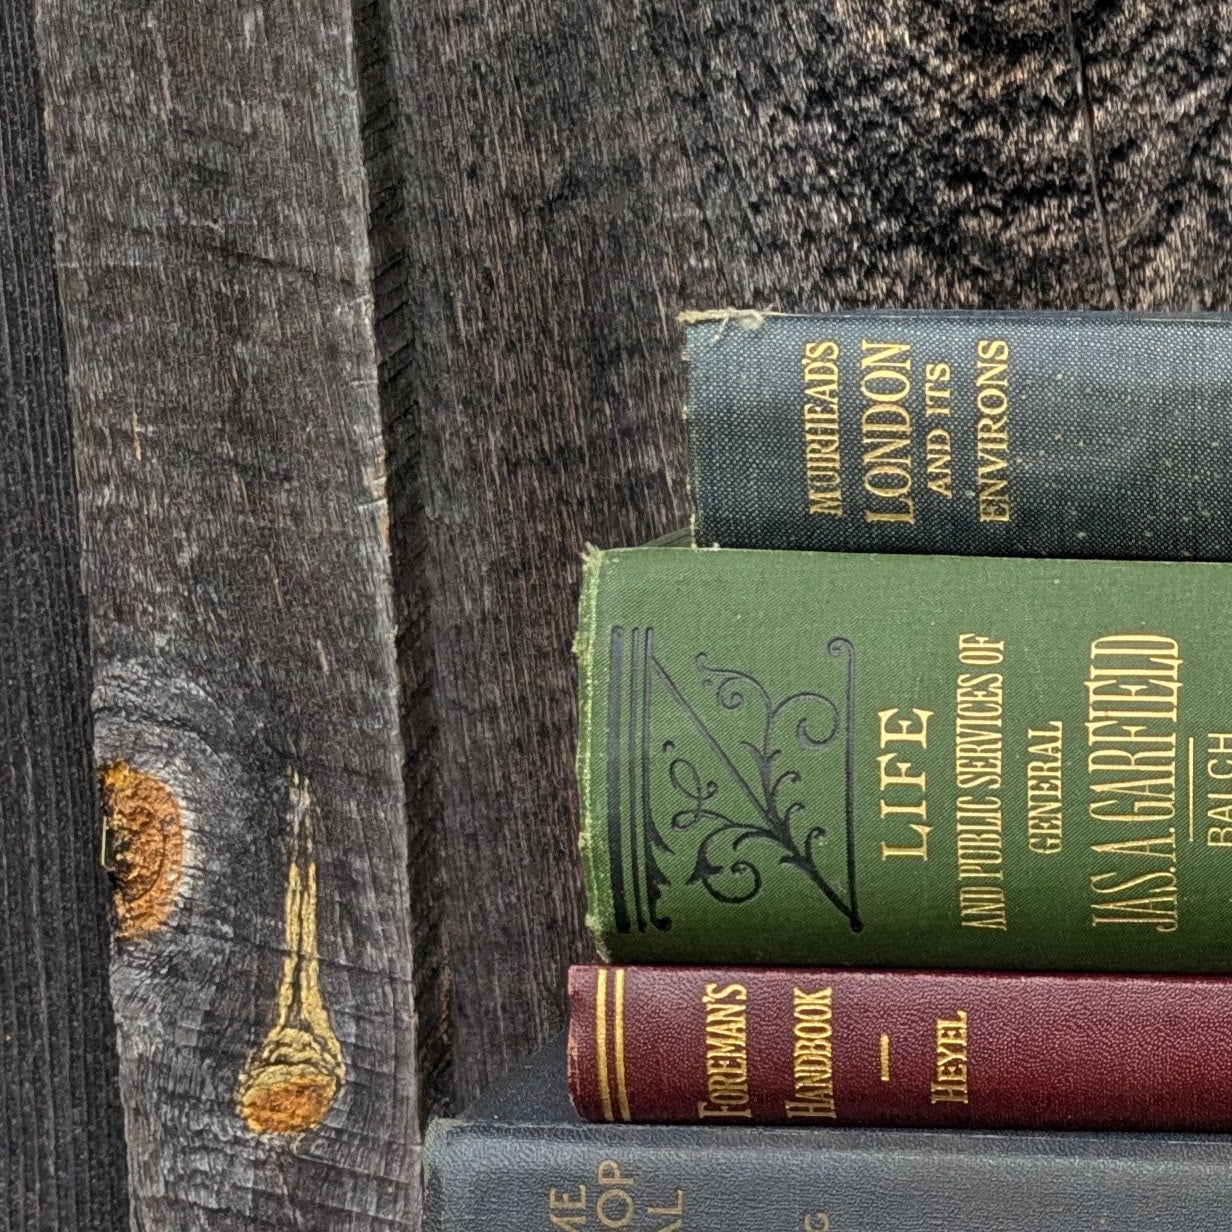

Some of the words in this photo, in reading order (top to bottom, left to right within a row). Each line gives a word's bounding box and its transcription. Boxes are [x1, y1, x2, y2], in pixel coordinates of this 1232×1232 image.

[802, 340, 843, 519] MUIRHEAD'S
[860, 338, 915, 524] LONDON
[925, 361, 951, 417] ITS
[976, 340, 1010, 523] ENVIRONS
[925, 428, 953, 499] AND
[958, 633, 1004, 665] OF
[876, 707, 935, 861] LIFE
[955, 673, 1004, 789] SERVICES
[1084, 634, 1184, 822] GARFIELD
[956, 796, 1004, 880] PUBLIC
[1027, 721, 1063, 854] GENERAL
[1090, 827, 1177, 863] A.
[959, 886, 1007, 931] AND
[1090, 866, 1178, 932] JAS.
[699, 983, 752, 1118] FOREMAN'S
[786, 986, 837, 1119] HANDBOOK
[931, 1010, 969, 1104] HEYEL
